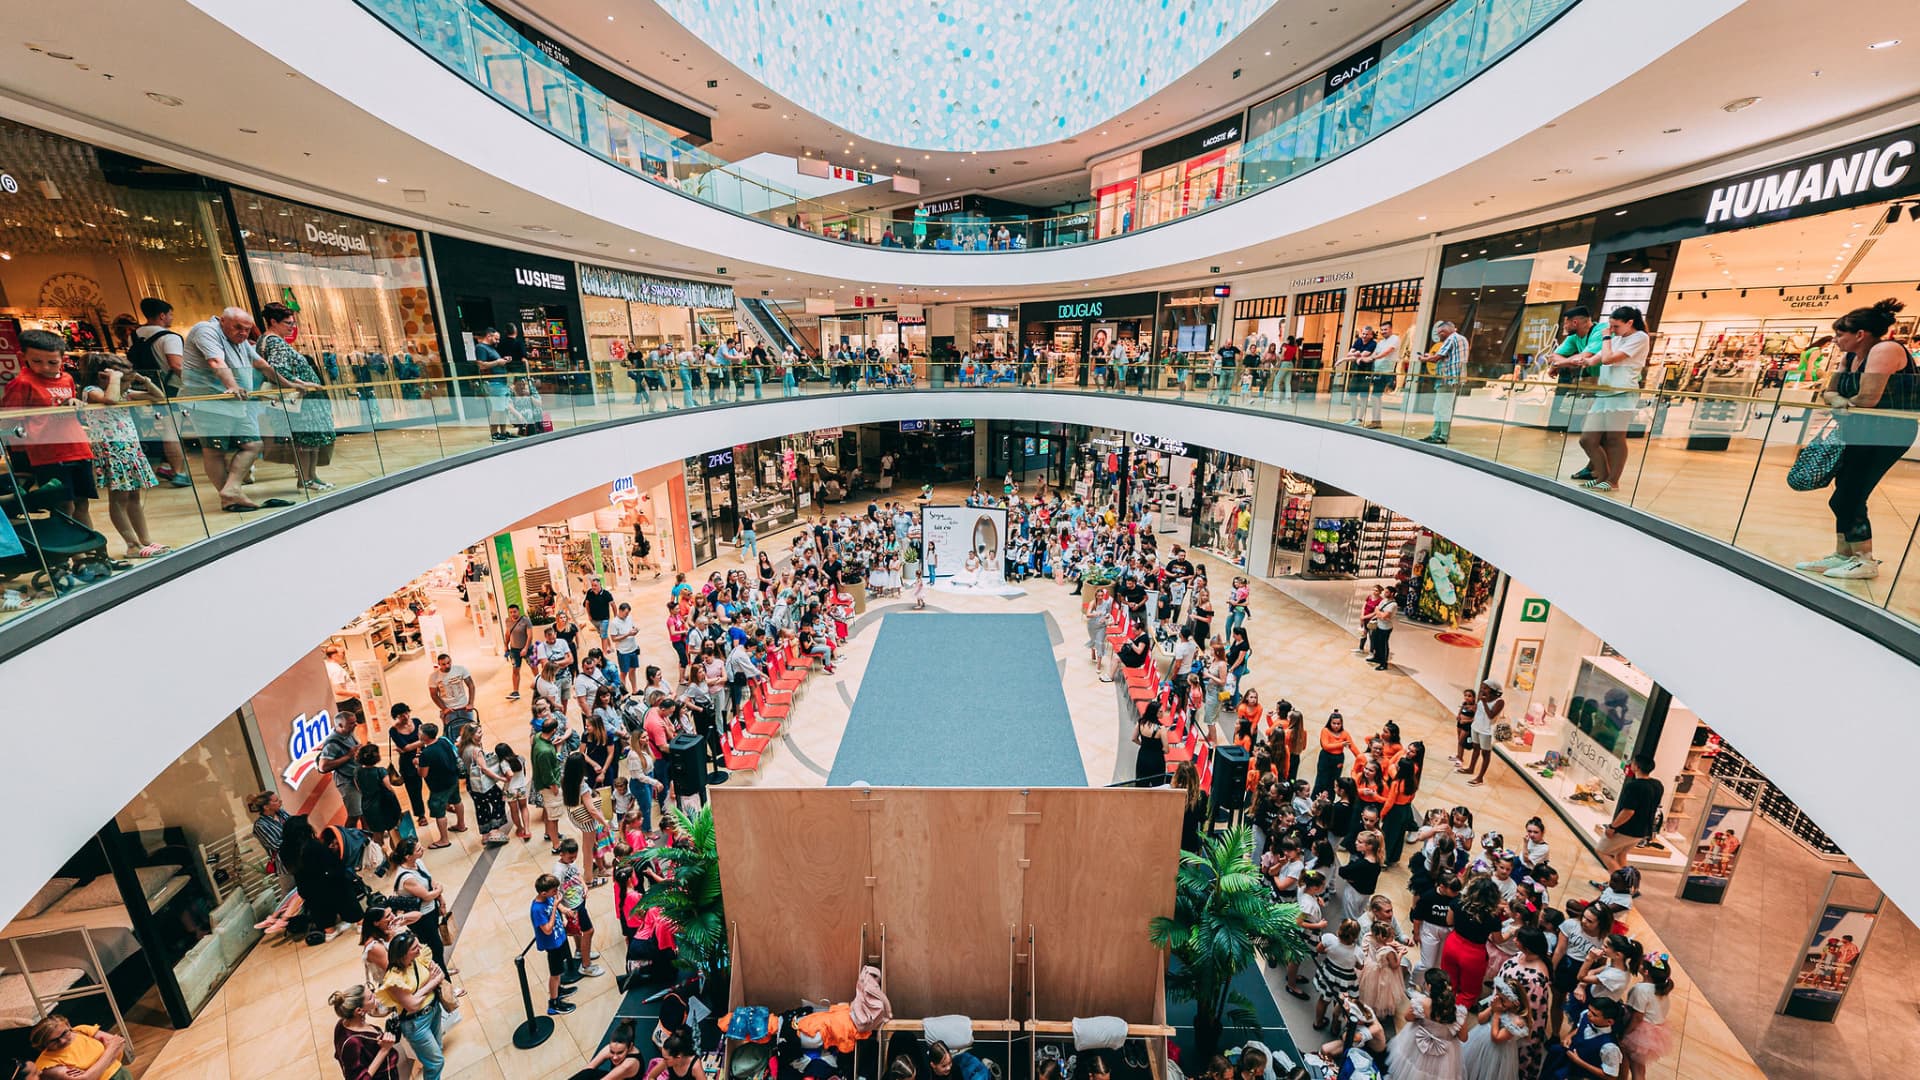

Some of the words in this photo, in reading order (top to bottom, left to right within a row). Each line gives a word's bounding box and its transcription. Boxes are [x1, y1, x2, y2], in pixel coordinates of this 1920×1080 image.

[536, 40, 553, 56] FIVE
[553, 50, 571, 66] STAR
[1330, 56, 1374, 87] GANT
[1202, 132, 1227, 148] LACOSTE
[1705, 140, 1916, 225] HUMANIC
[304, 223, 369, 252] Desigual
[515, 268, 551, 289] LUSH
[1325, 271, 1354, 282] HILFIGER
[1806, 293, 1839, 301] CIPELA
[1058, 302, 1102, 319] DOUGLAS
[741, 312, 766, 344] LACOSTE
[1132, 432, 1151, 447] OS
[708, 451, 733, 468] ZAKS
[614, 476, 633, 492] dm
[1526, 602, 1546, 619] D
[293, 714, 330, 760] dm
